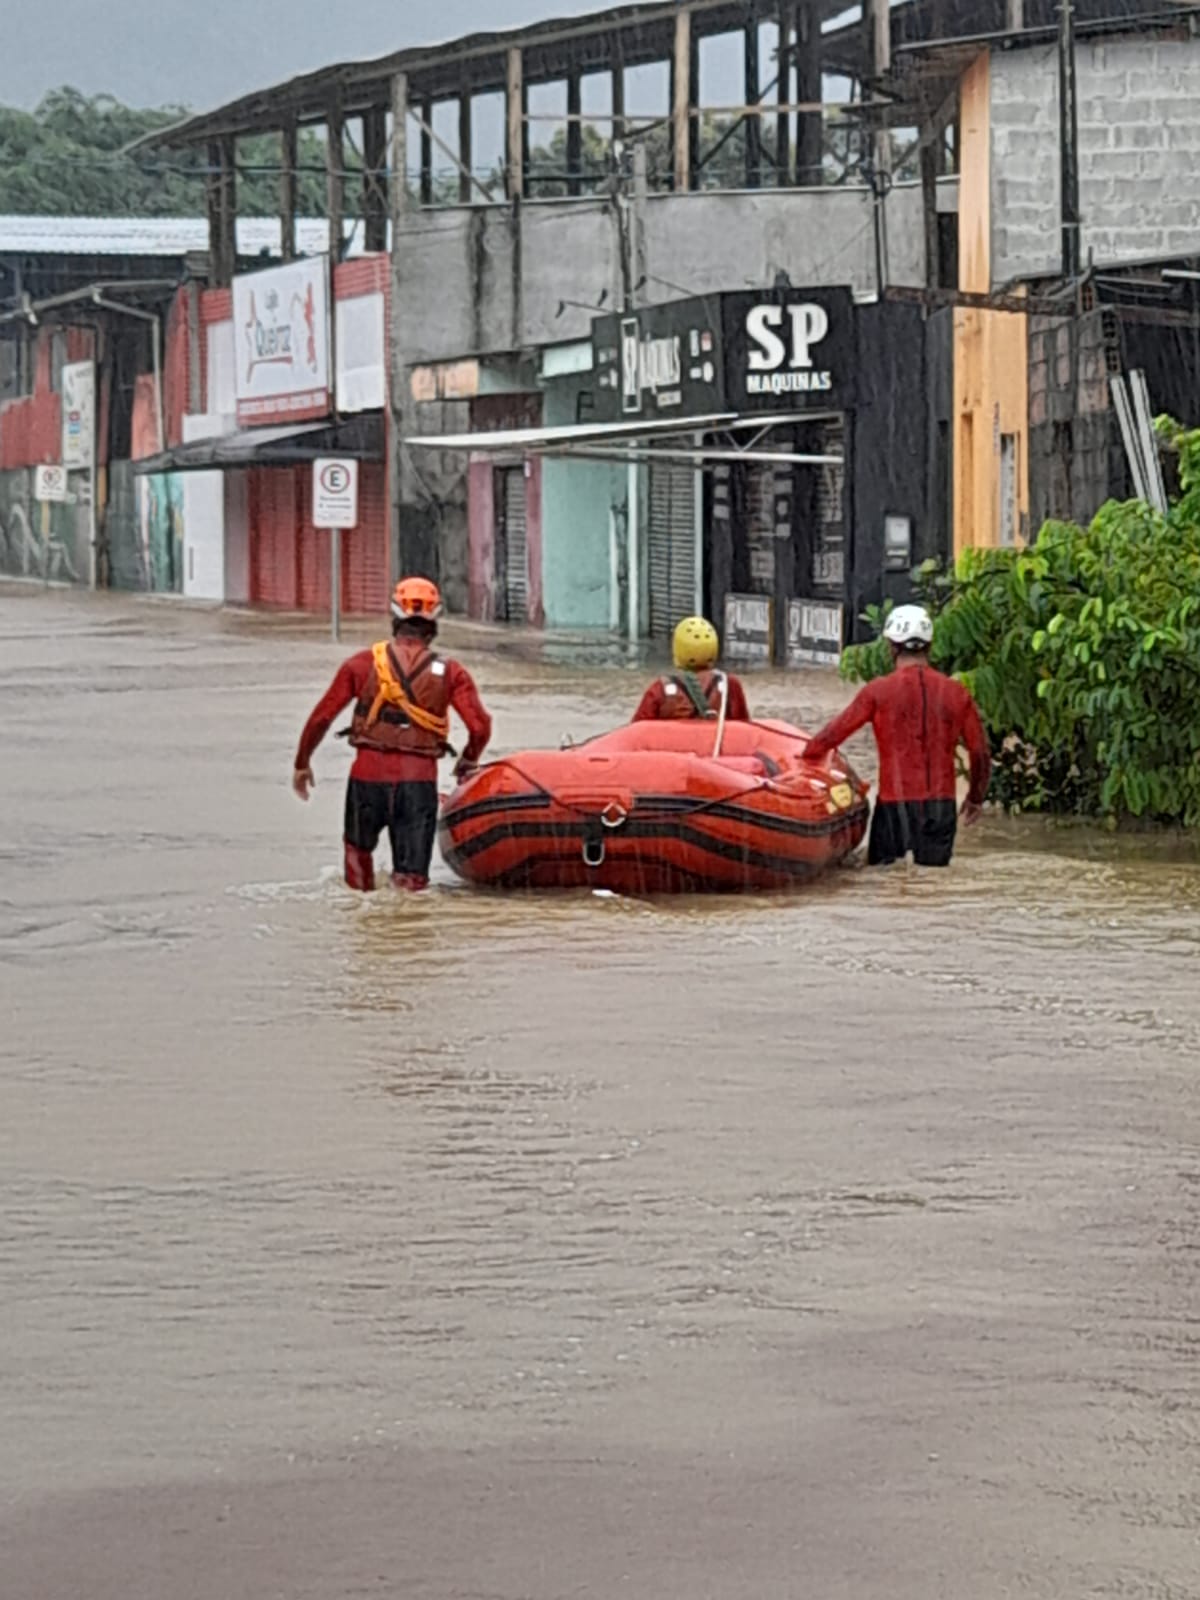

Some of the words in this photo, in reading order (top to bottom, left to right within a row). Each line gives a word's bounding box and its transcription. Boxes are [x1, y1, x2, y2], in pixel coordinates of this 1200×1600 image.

[746, 303, 829, 370] SP
[746, 371, 832, 395] MAQUINAS
[330, 470, 341, 487] E
